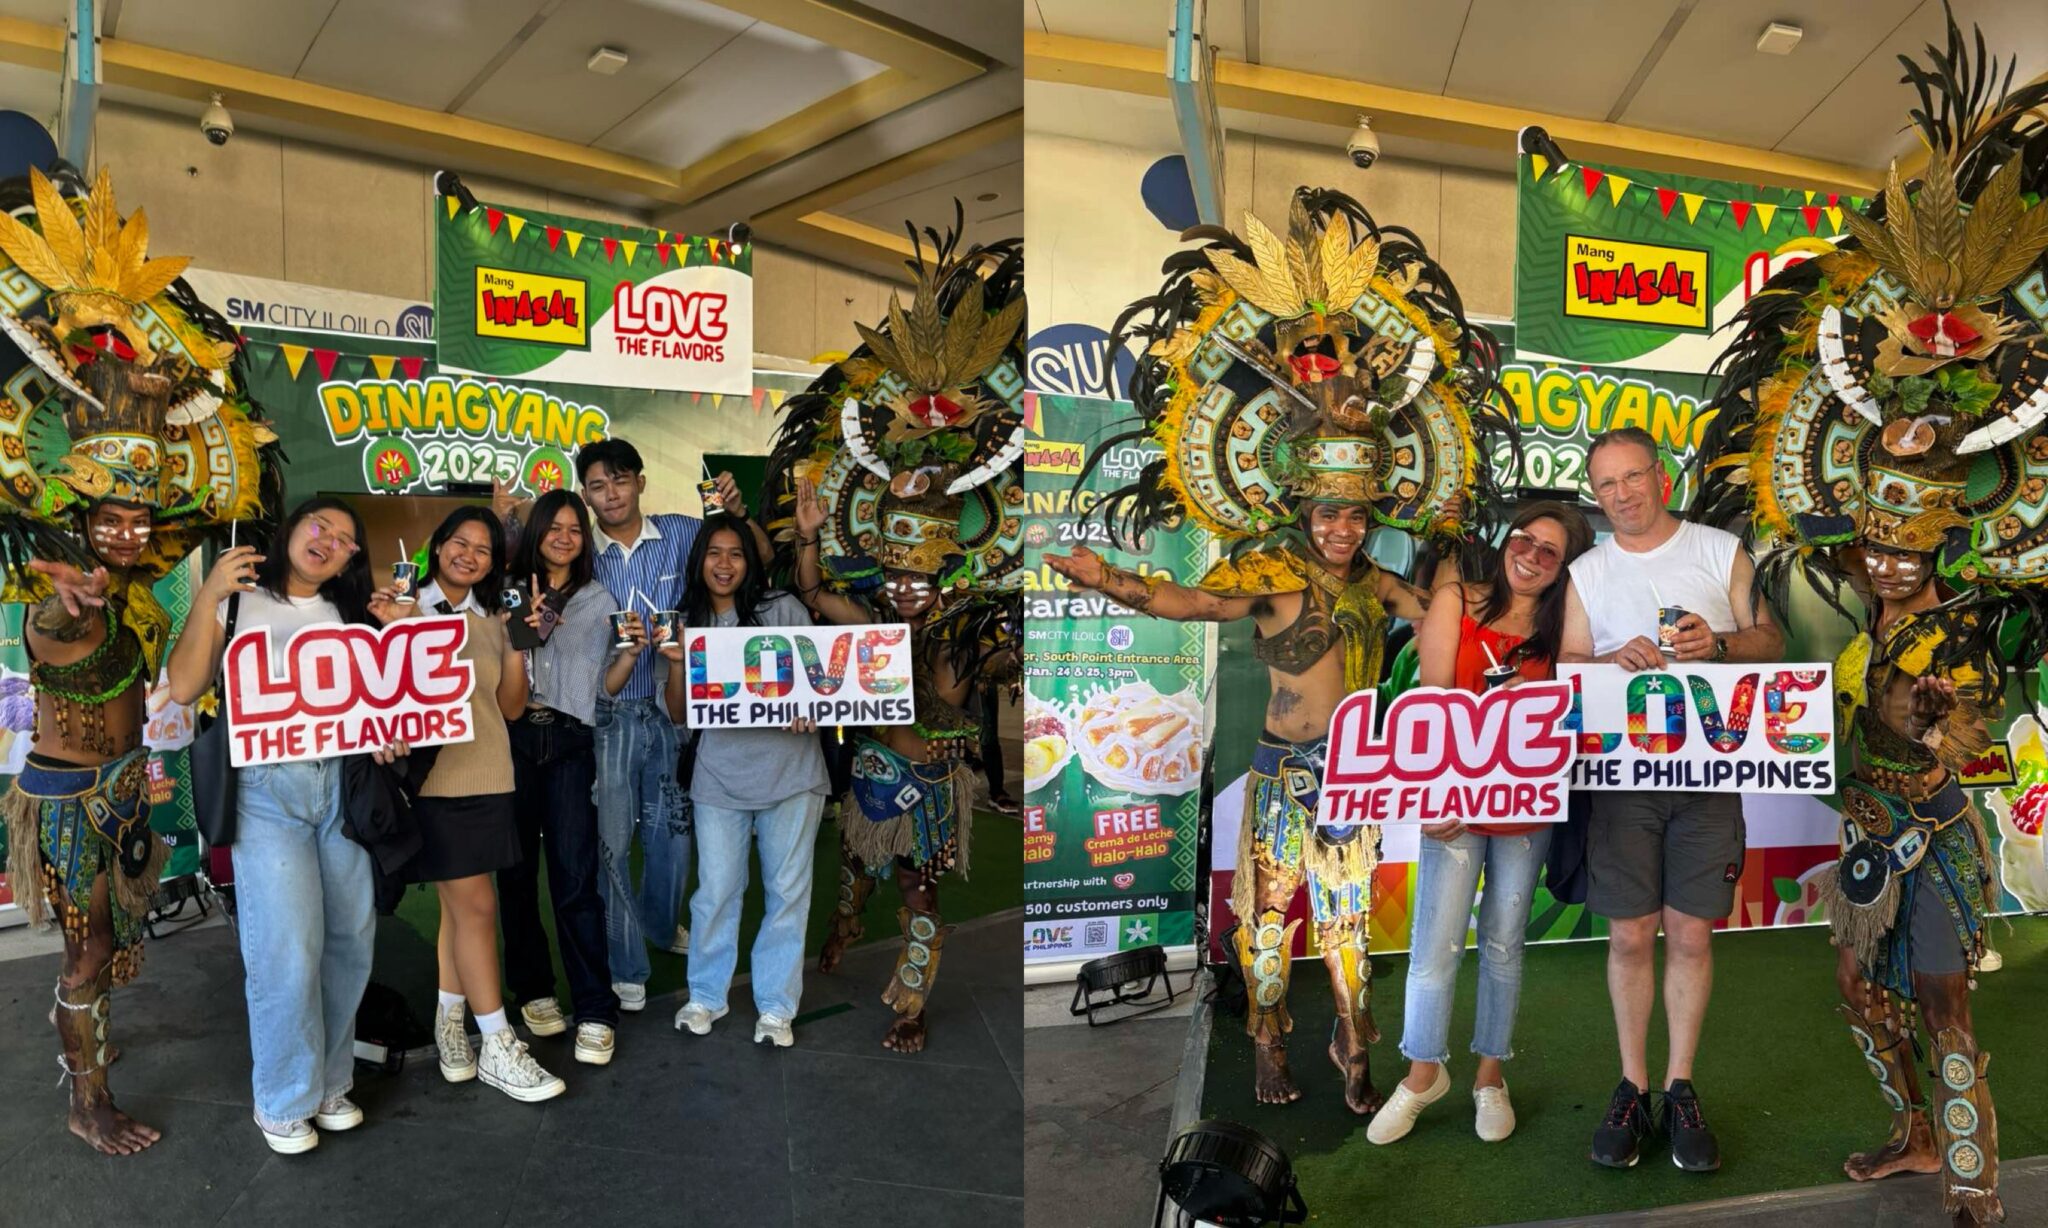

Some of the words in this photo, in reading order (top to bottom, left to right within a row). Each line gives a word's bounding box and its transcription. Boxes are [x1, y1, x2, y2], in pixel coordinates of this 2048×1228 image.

[1577, 243, 1615, 262] Mang
[484, 273, 515, 289] Mang
[1574, 261, 1697, 307] INASAL
[226, 297, 265, 322] SM
[268, 303, 317, 327] CITY
[482, 289, 578, 328] INASAL
[613, 280, 728, 342] LOVE
[615, 336, 648, 355] THE
[652, 340, 725, 363] FLAVORS
[320, 381, 606, 449] DINAGYANG
[423, 448, 518, 483] 2025
[1103, 469, 1121, 478] THE
[1495, 447, 1593, 489] 202
[1024, 595, 1136, 619] arava
[1028, 629, 1047, 640] SM
[1047, 630, 1070, 641] CITY
[1071, 630, 1105, 641] ILOILO
[227, 618, 470, 726] LOVE
[689, 628, 911, 700] LOVE
[1024, 666, 1053, 677] Jan.
[1056, 667, 1071, 677] 24
[1073, 667, 1083, 677] &
[1086, 667, 1104, 679] 25,
[1108, 668, 1134, 679] 3pm
[1043, 651, 1079, 663] South
[1082, 653, 1113, 664] Point
[1116, 654, 1170, 665] Entrance
[1173, 655, 1200, 665] Area
[691, 702, 742, 725] THE
[750, 698, 913, 724] PHILIPPINES
[234, 724, 306, 762] THE
[314, 706, 468, 754] FLAVORS
[1325, 684, 1572, 786] LOVE
[1571, 759, 1622, 787] THE
[1632, 759, 1833, 789] PHILIPPINES
[1325, 787, 1393, 822] THE
[1397, 782, 1562, 820] FLAVORS
[1097, 807, 1159, 836] FREE
[1087, 837, 1124, 850] Crema
[1127, 834, 1140, 844] de
[1143, 829, 1173, 841] Leche
[1094, 843, 1167, 865] Halo-Halo
[1083, 876, 1107, 887] with
[1025, 902, 1052, 915] 500
[1056, 898, 1133, 914] customers
[1137, 895, 1169, 910] only
